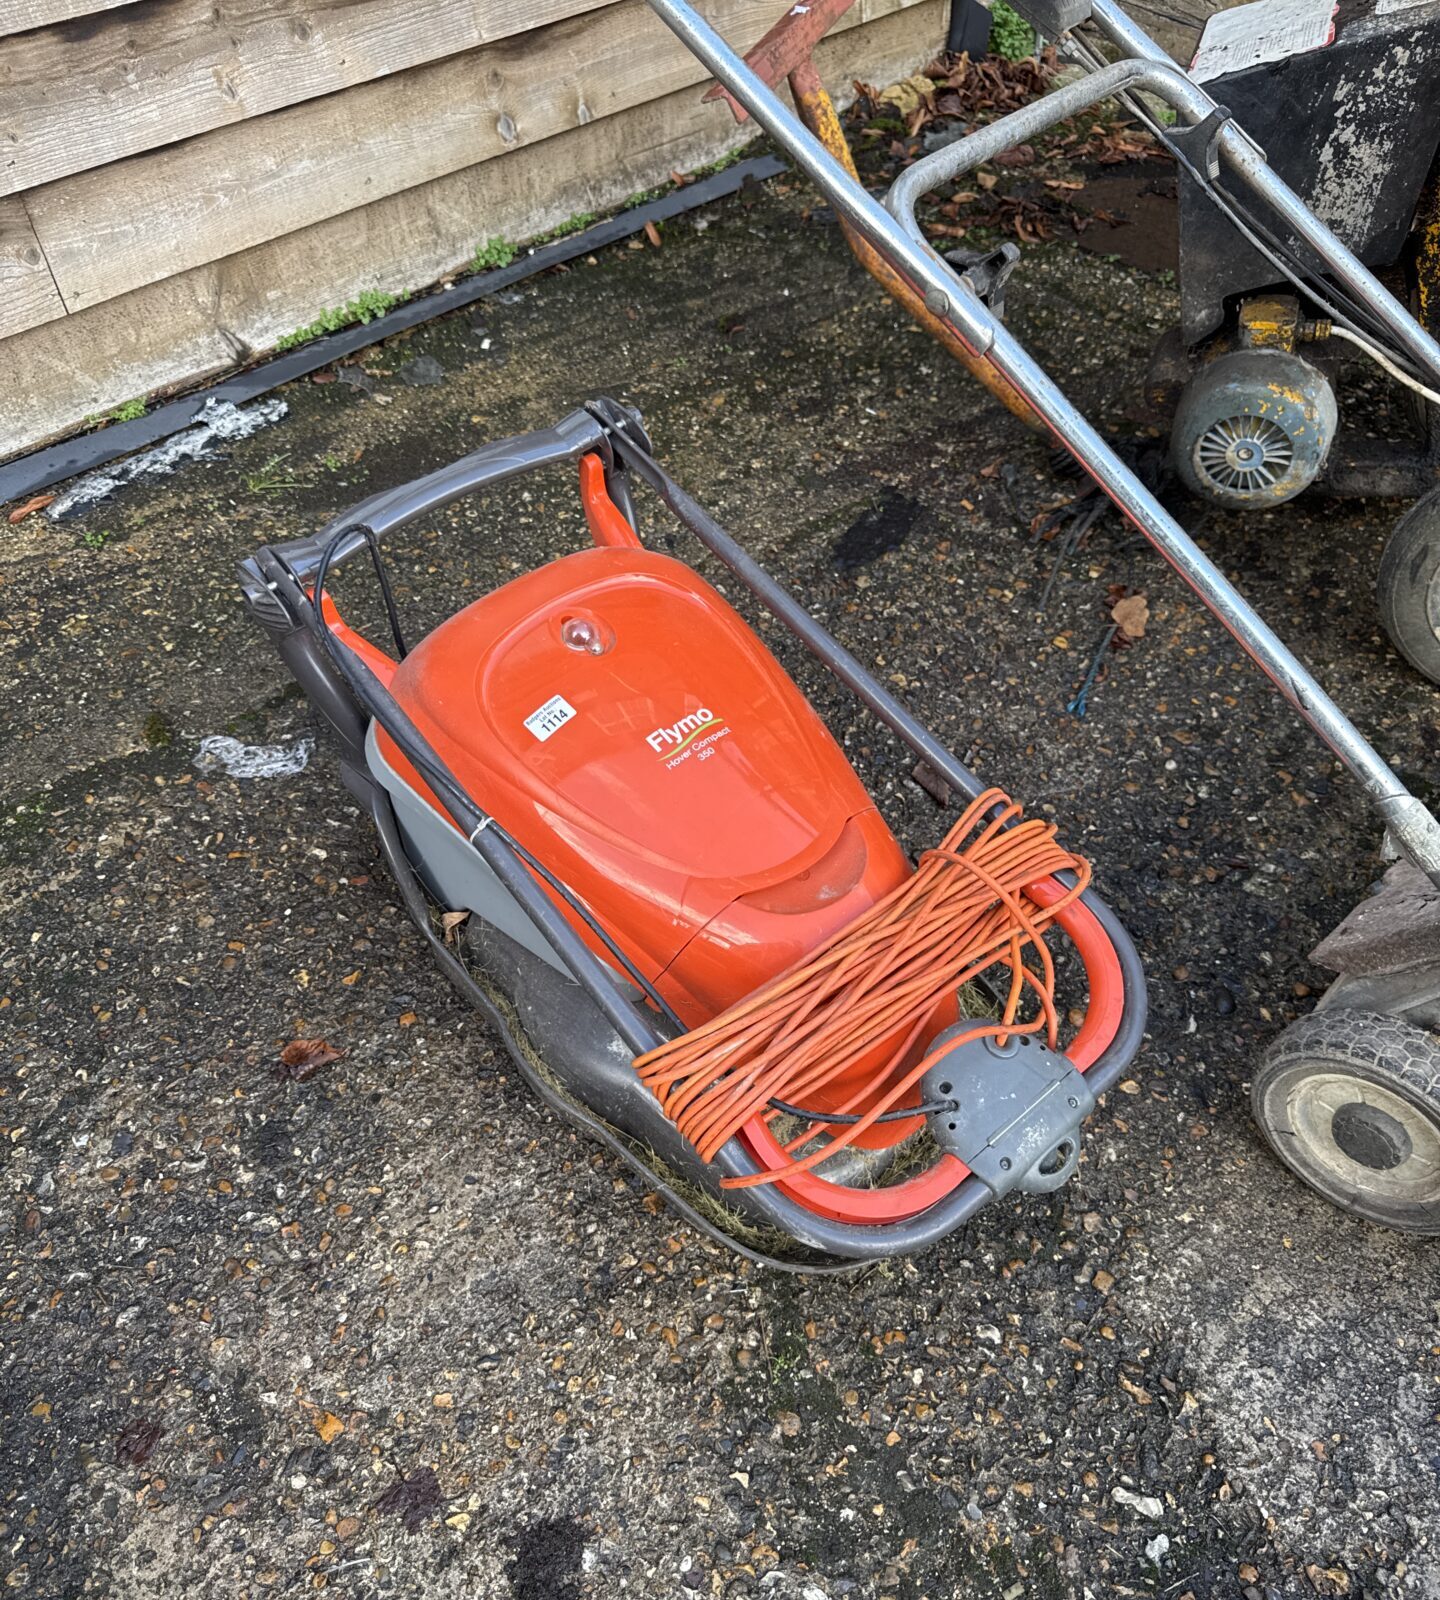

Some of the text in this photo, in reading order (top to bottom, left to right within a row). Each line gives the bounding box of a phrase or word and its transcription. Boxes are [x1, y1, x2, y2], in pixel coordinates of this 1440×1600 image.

[539, 714, 548, 722] Lot
[542, 709, 568, 732] 1114
[646, 708, 713, 752] Flymo
[666, 726, 731, 770] Hover Compact
[697, 746, 716, 761] 350
